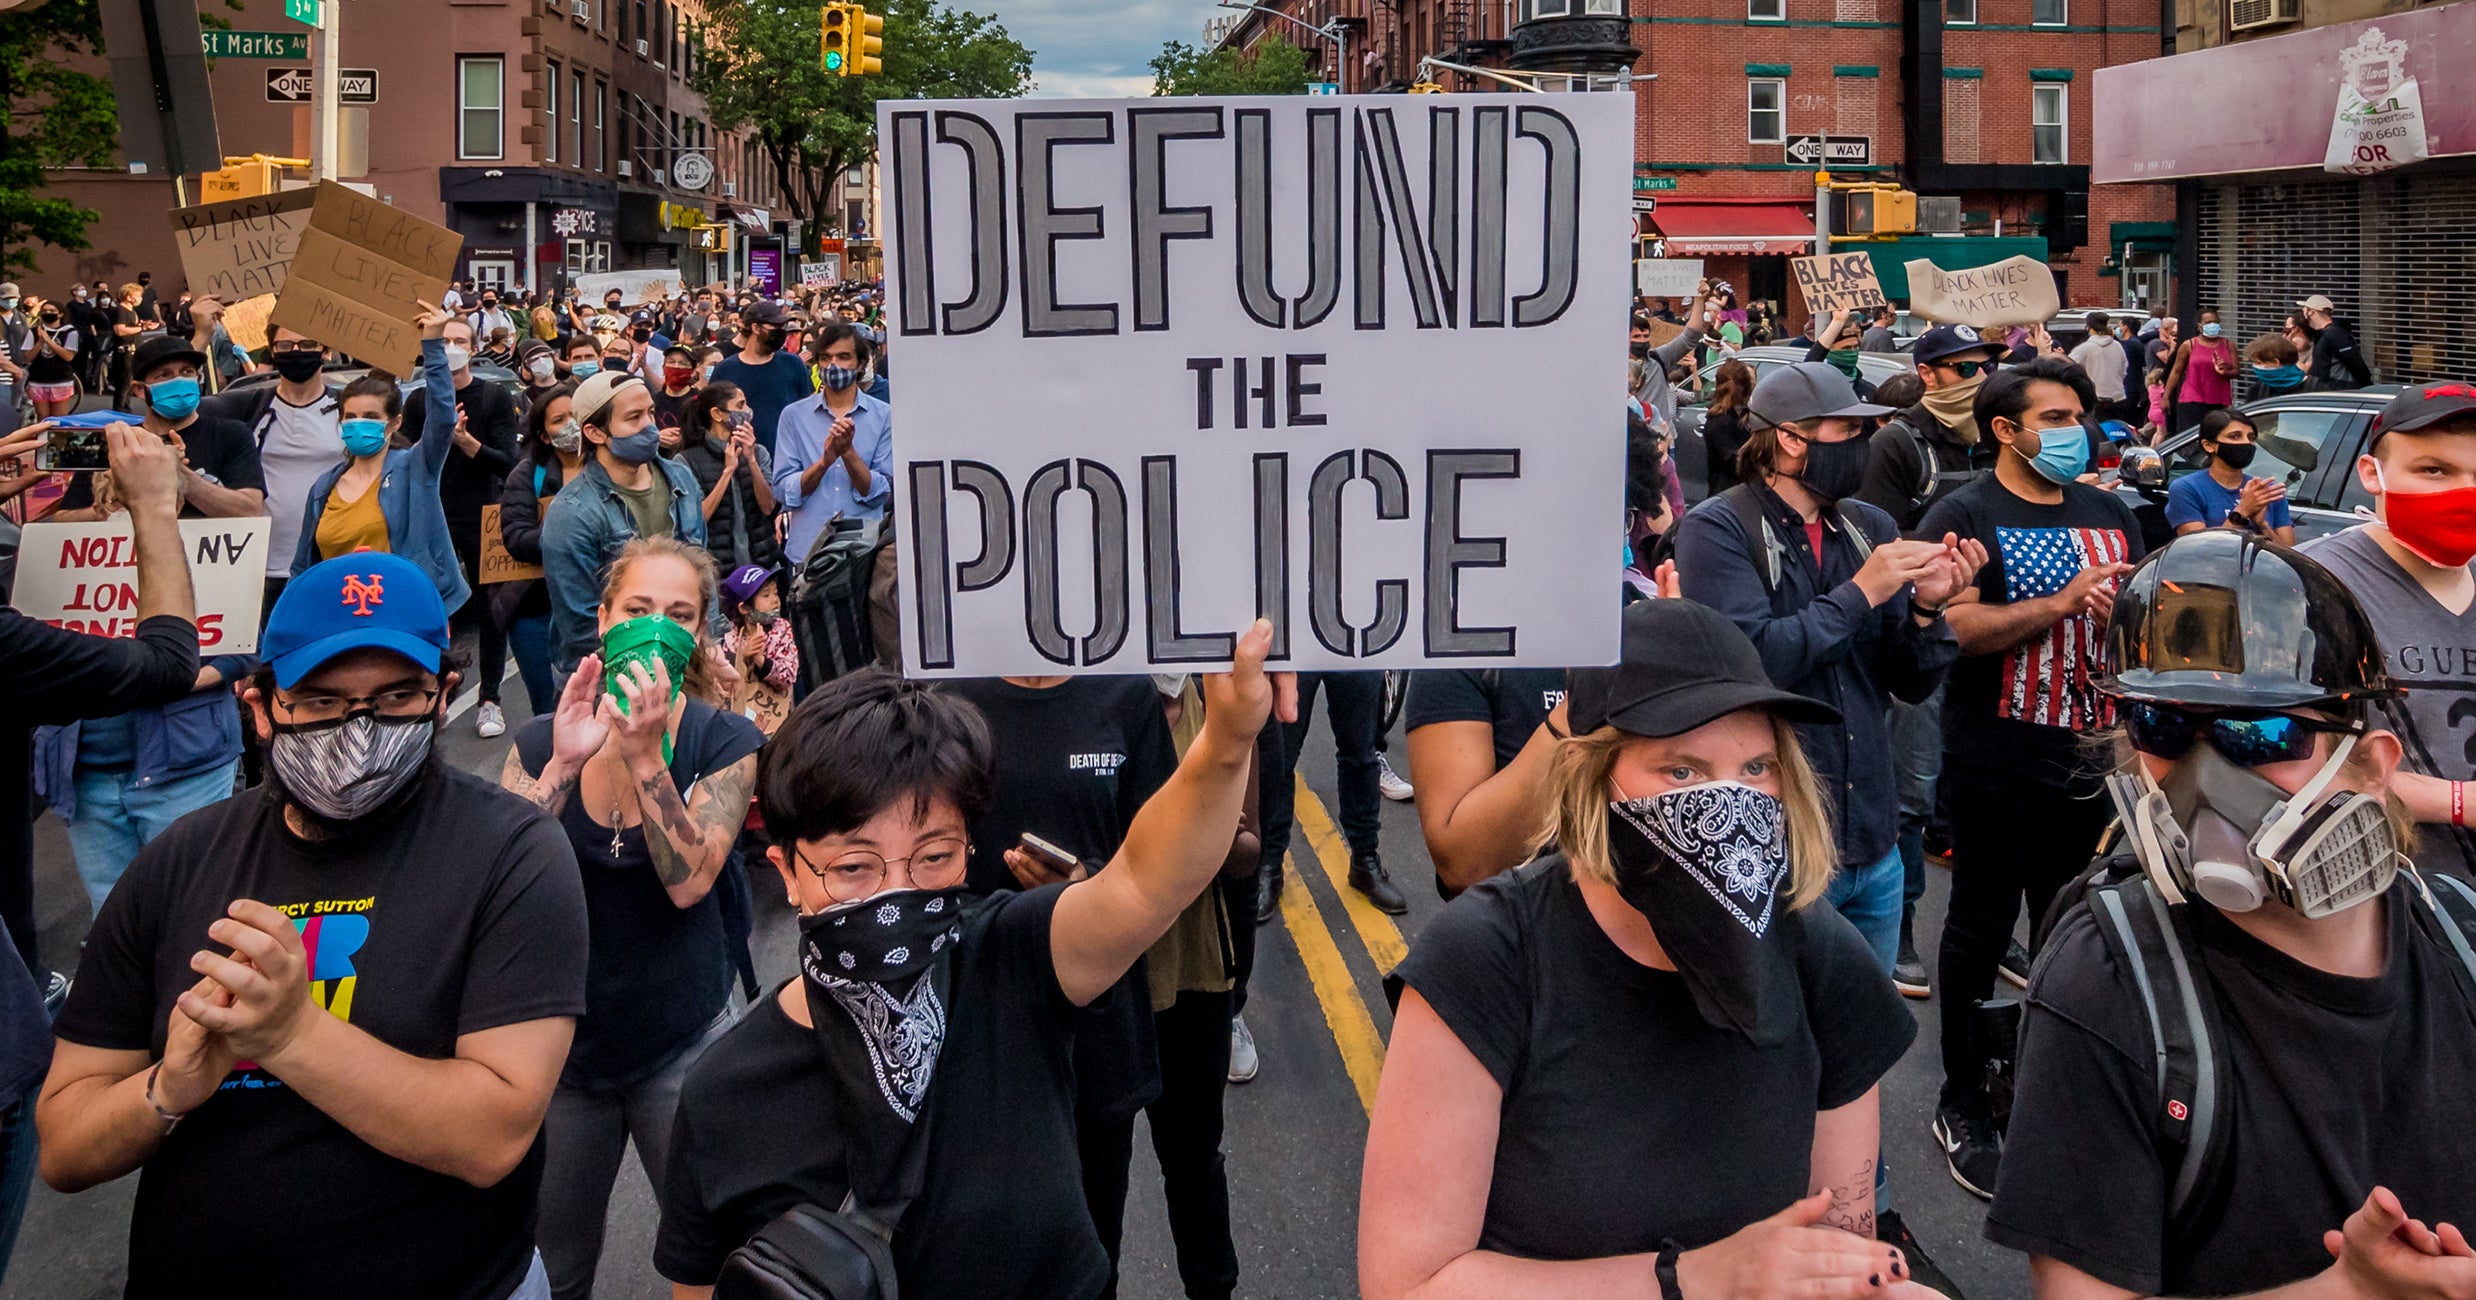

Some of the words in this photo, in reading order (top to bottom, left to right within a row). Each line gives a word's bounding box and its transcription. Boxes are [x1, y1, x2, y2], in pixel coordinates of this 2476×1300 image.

[202, 33, 218, 53] St
[228, 35, 284, 55] Marks
[278, 78, 312, 92] ONE
[2363, 111, 2416, 126] Properties
[2376, 127, 2407, 140] 6603
[1797, 145, 1821, 155] ONE
[1836, 145, 1862, 155] WAY
[1644, 179, 1668, 188] Marks
[181, 201, 291, 247] BLACK
[348, 200, 446, 267] BLACK
[891, 105, 1581, 337] DEFUND
[234, 232, 303, 267] LIVE
[1729, 243, 1749, 251] FOOD
[208, 260, 292, 295] MATT
[331, 249, 425, 303] LIVES
[804, 264, 831, 273] BLACK
[807, 272, 829, 280] LIVES
[1794, 254, 1876, 285] BLACK
[1932, 267, 1979, 294] BLACK
[1982, 264, 2028, 291] LIVES
[1644, 275, 1696, 288] MATTER
[1812, 279, 1860, 294] LIVES
[1806, 288, 1885, 312] MATTER
[1953, 290, 2026, 316] MATTER
[308, 297, 398, 351] MATTER
[1186, 353, 1327, 430] THE
[196, 532, 254, 566] AN
[908, 448, 1521, 669] POLICE
[62, 582, 139, 613] NOT
[1070, 753, 1100, 769] DEATH
[1101, 753, 1111, 768] OF
[313, 896, 375, 913] SUTTON
